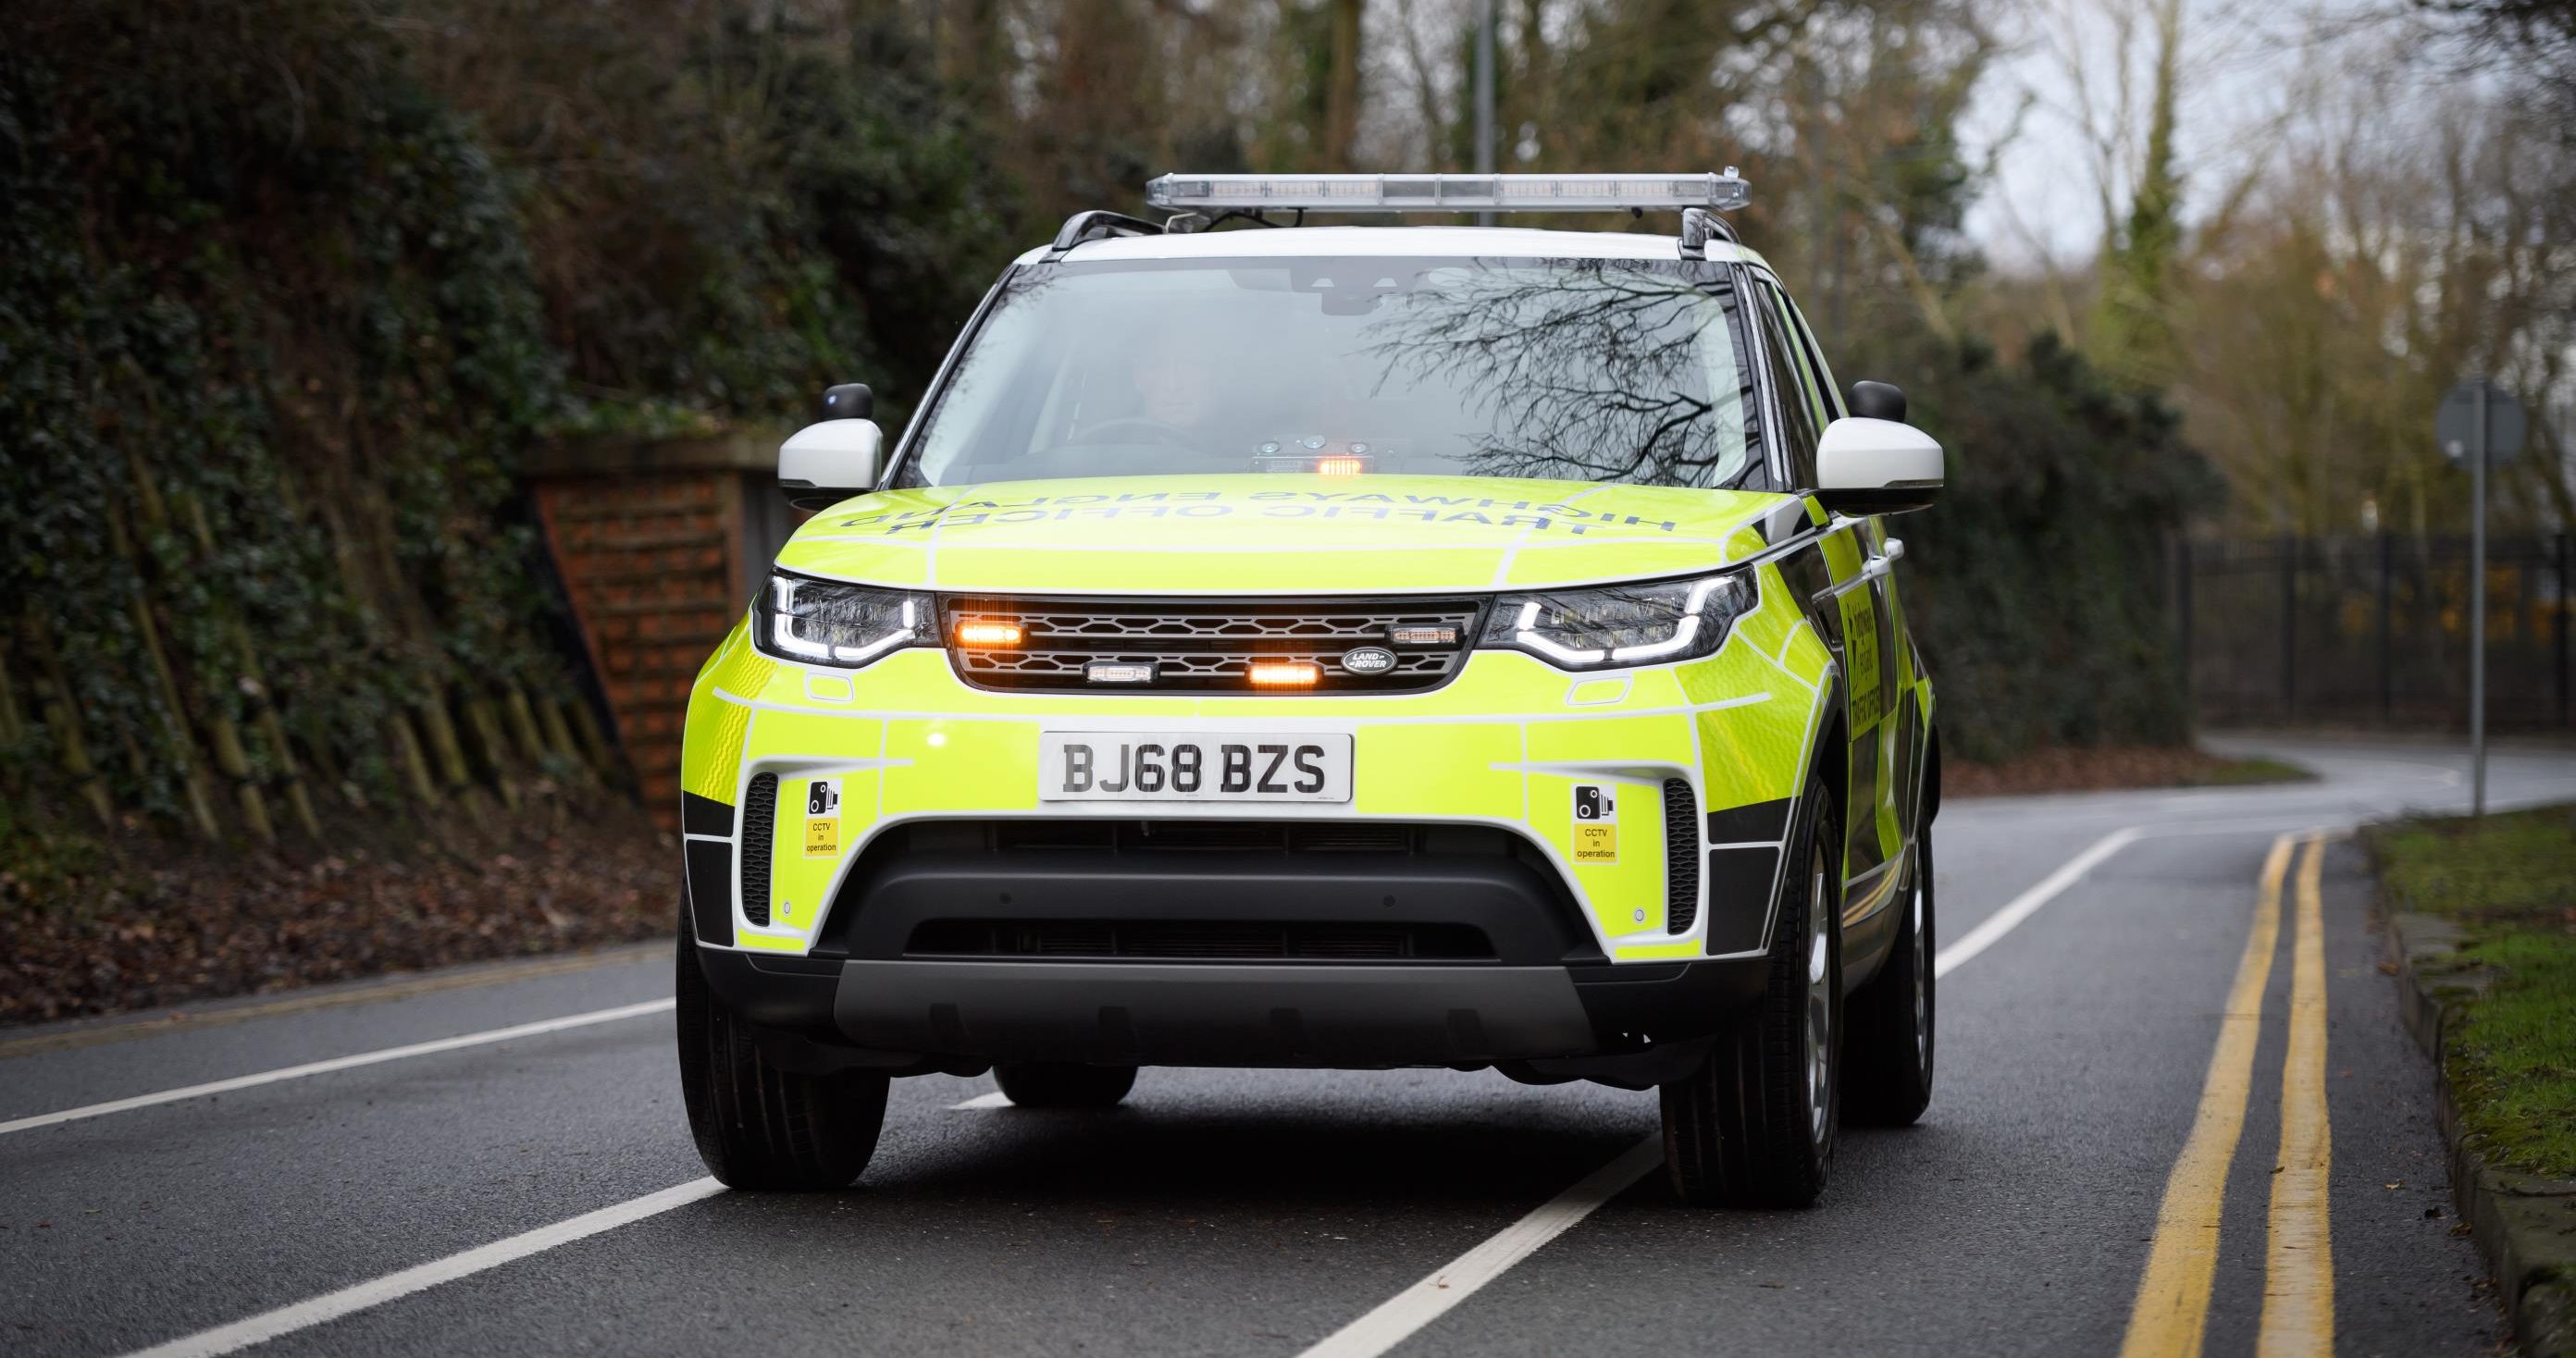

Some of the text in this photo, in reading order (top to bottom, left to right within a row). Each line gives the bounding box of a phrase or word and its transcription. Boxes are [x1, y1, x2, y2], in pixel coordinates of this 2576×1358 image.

[1352, 652, 1380, 660] LAND
[1354, 660, 1387, 668] ROVER
[1062, 744, 1326, 794] BJ68 BZS
[812, 822, 831, 831] CCTV
[1584, 828, 1608, 837] CCTV
[1592, 839, 1601, 847] in
[806, 843, 836, 854] operation
[1577, 850, 1616, 858] operation
